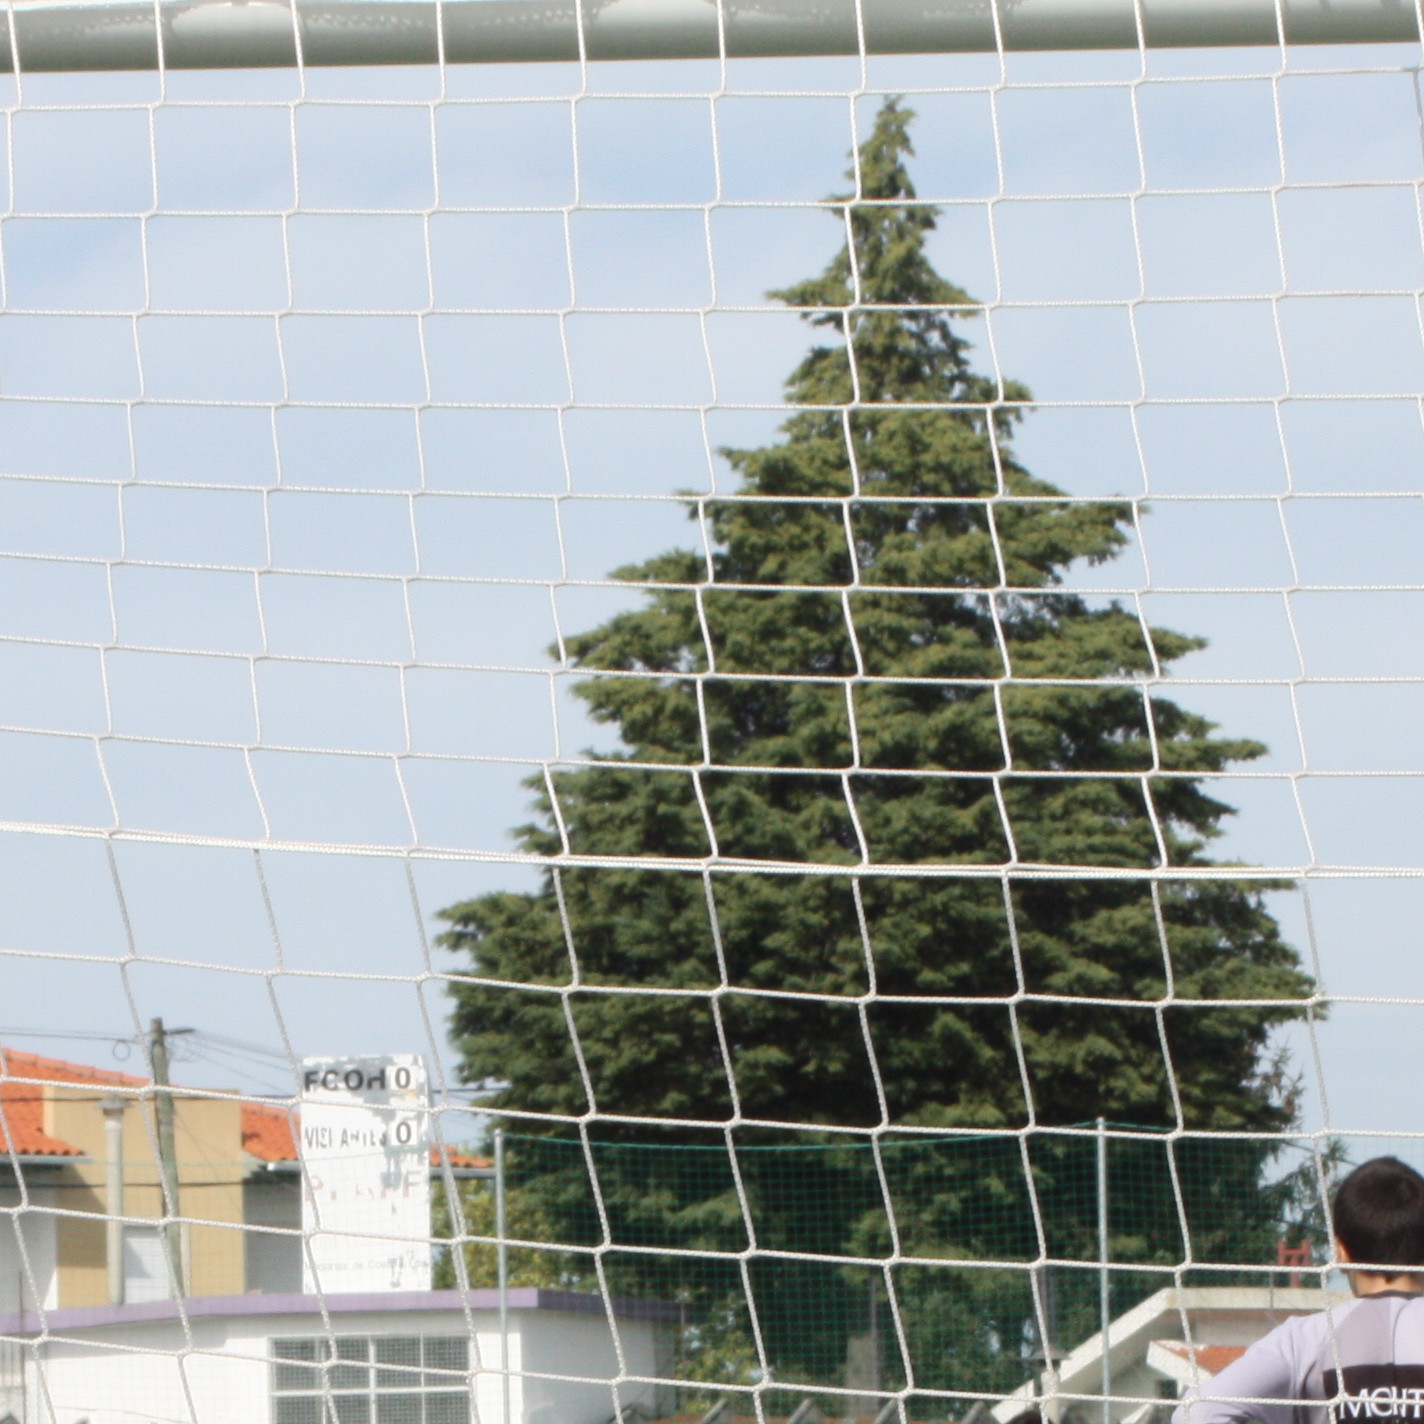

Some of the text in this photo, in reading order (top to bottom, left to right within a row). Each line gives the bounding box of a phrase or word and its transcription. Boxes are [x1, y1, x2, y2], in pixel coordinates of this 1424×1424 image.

[304, 1066, 411, 1092] FCOH 0
[395, 1121, 412, 1145] 0
